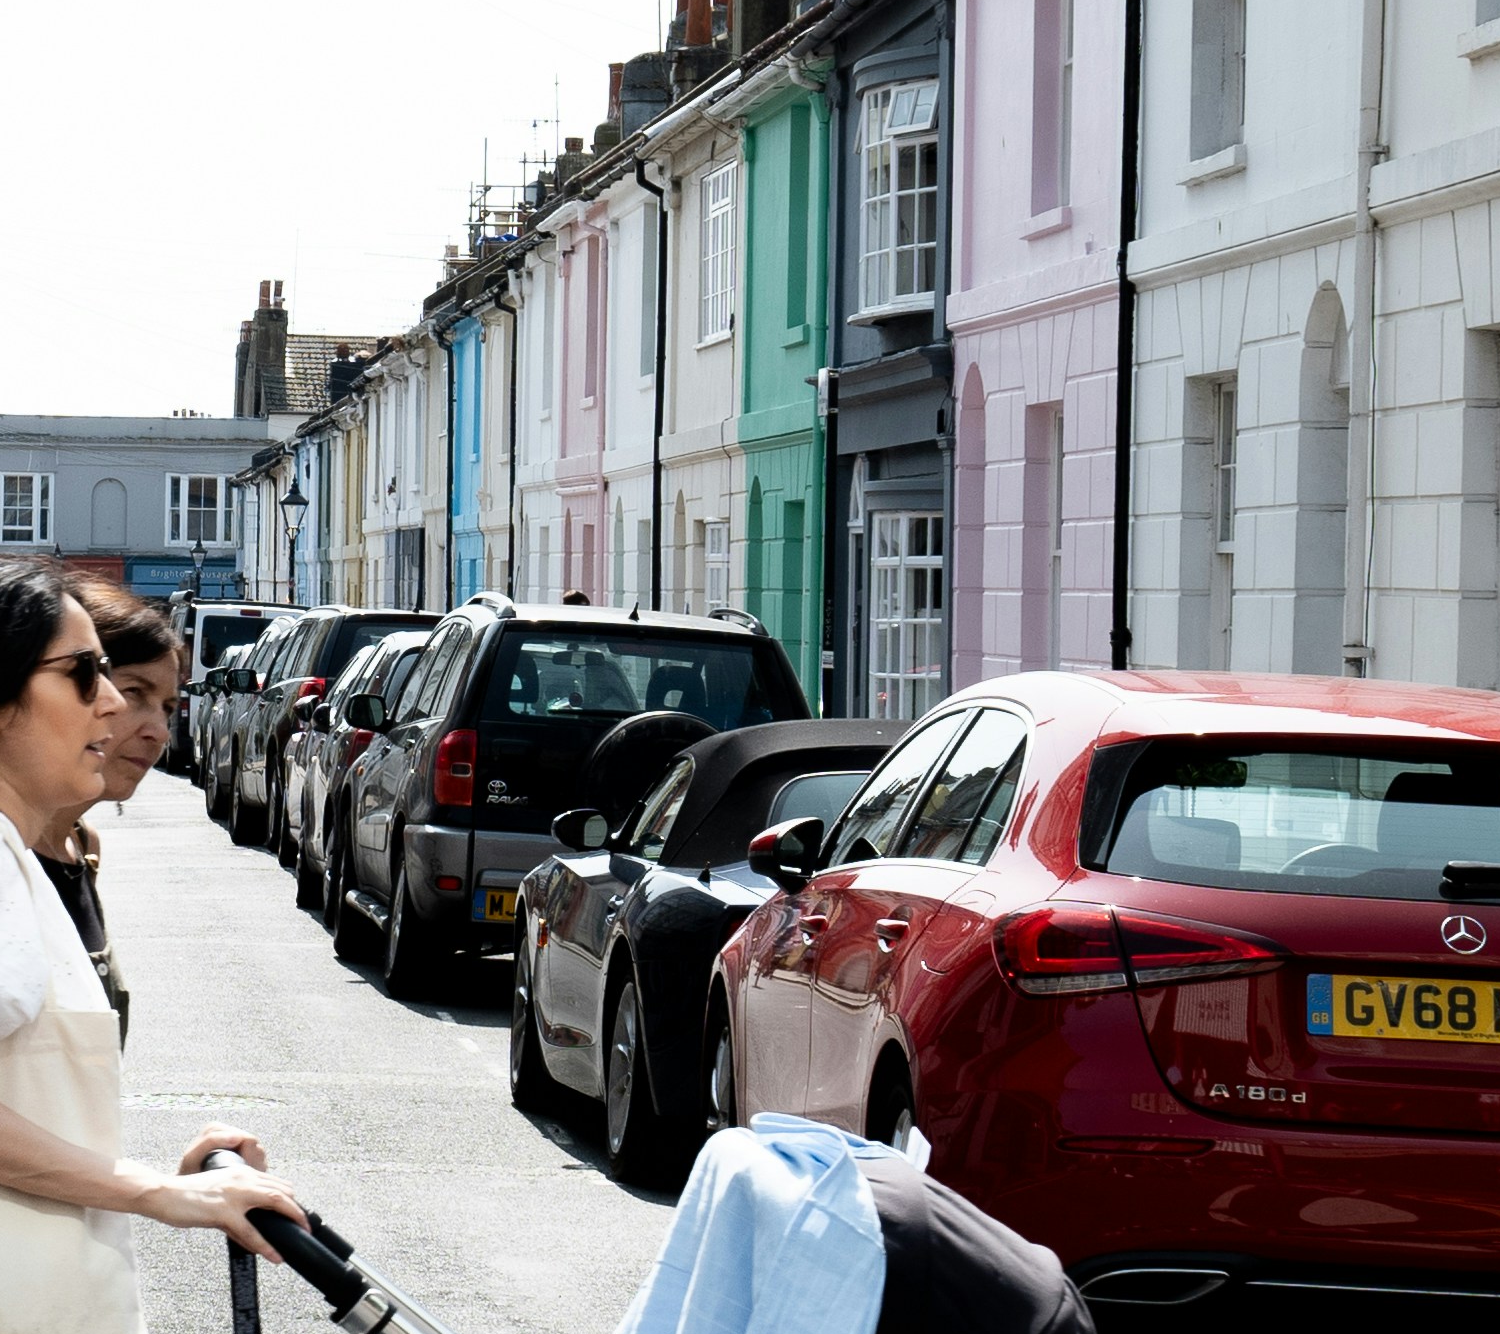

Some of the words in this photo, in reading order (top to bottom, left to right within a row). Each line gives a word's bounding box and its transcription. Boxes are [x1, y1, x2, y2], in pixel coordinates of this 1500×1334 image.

[1345, 981, 1477, 1032] GV68
[1311, 1012, 1329, 1024] GB
[1208, 1083, 1230, 1098] A
[1235, 1084, 1287, 1102] 180
[1291, 1091, 1306, 1103] d
